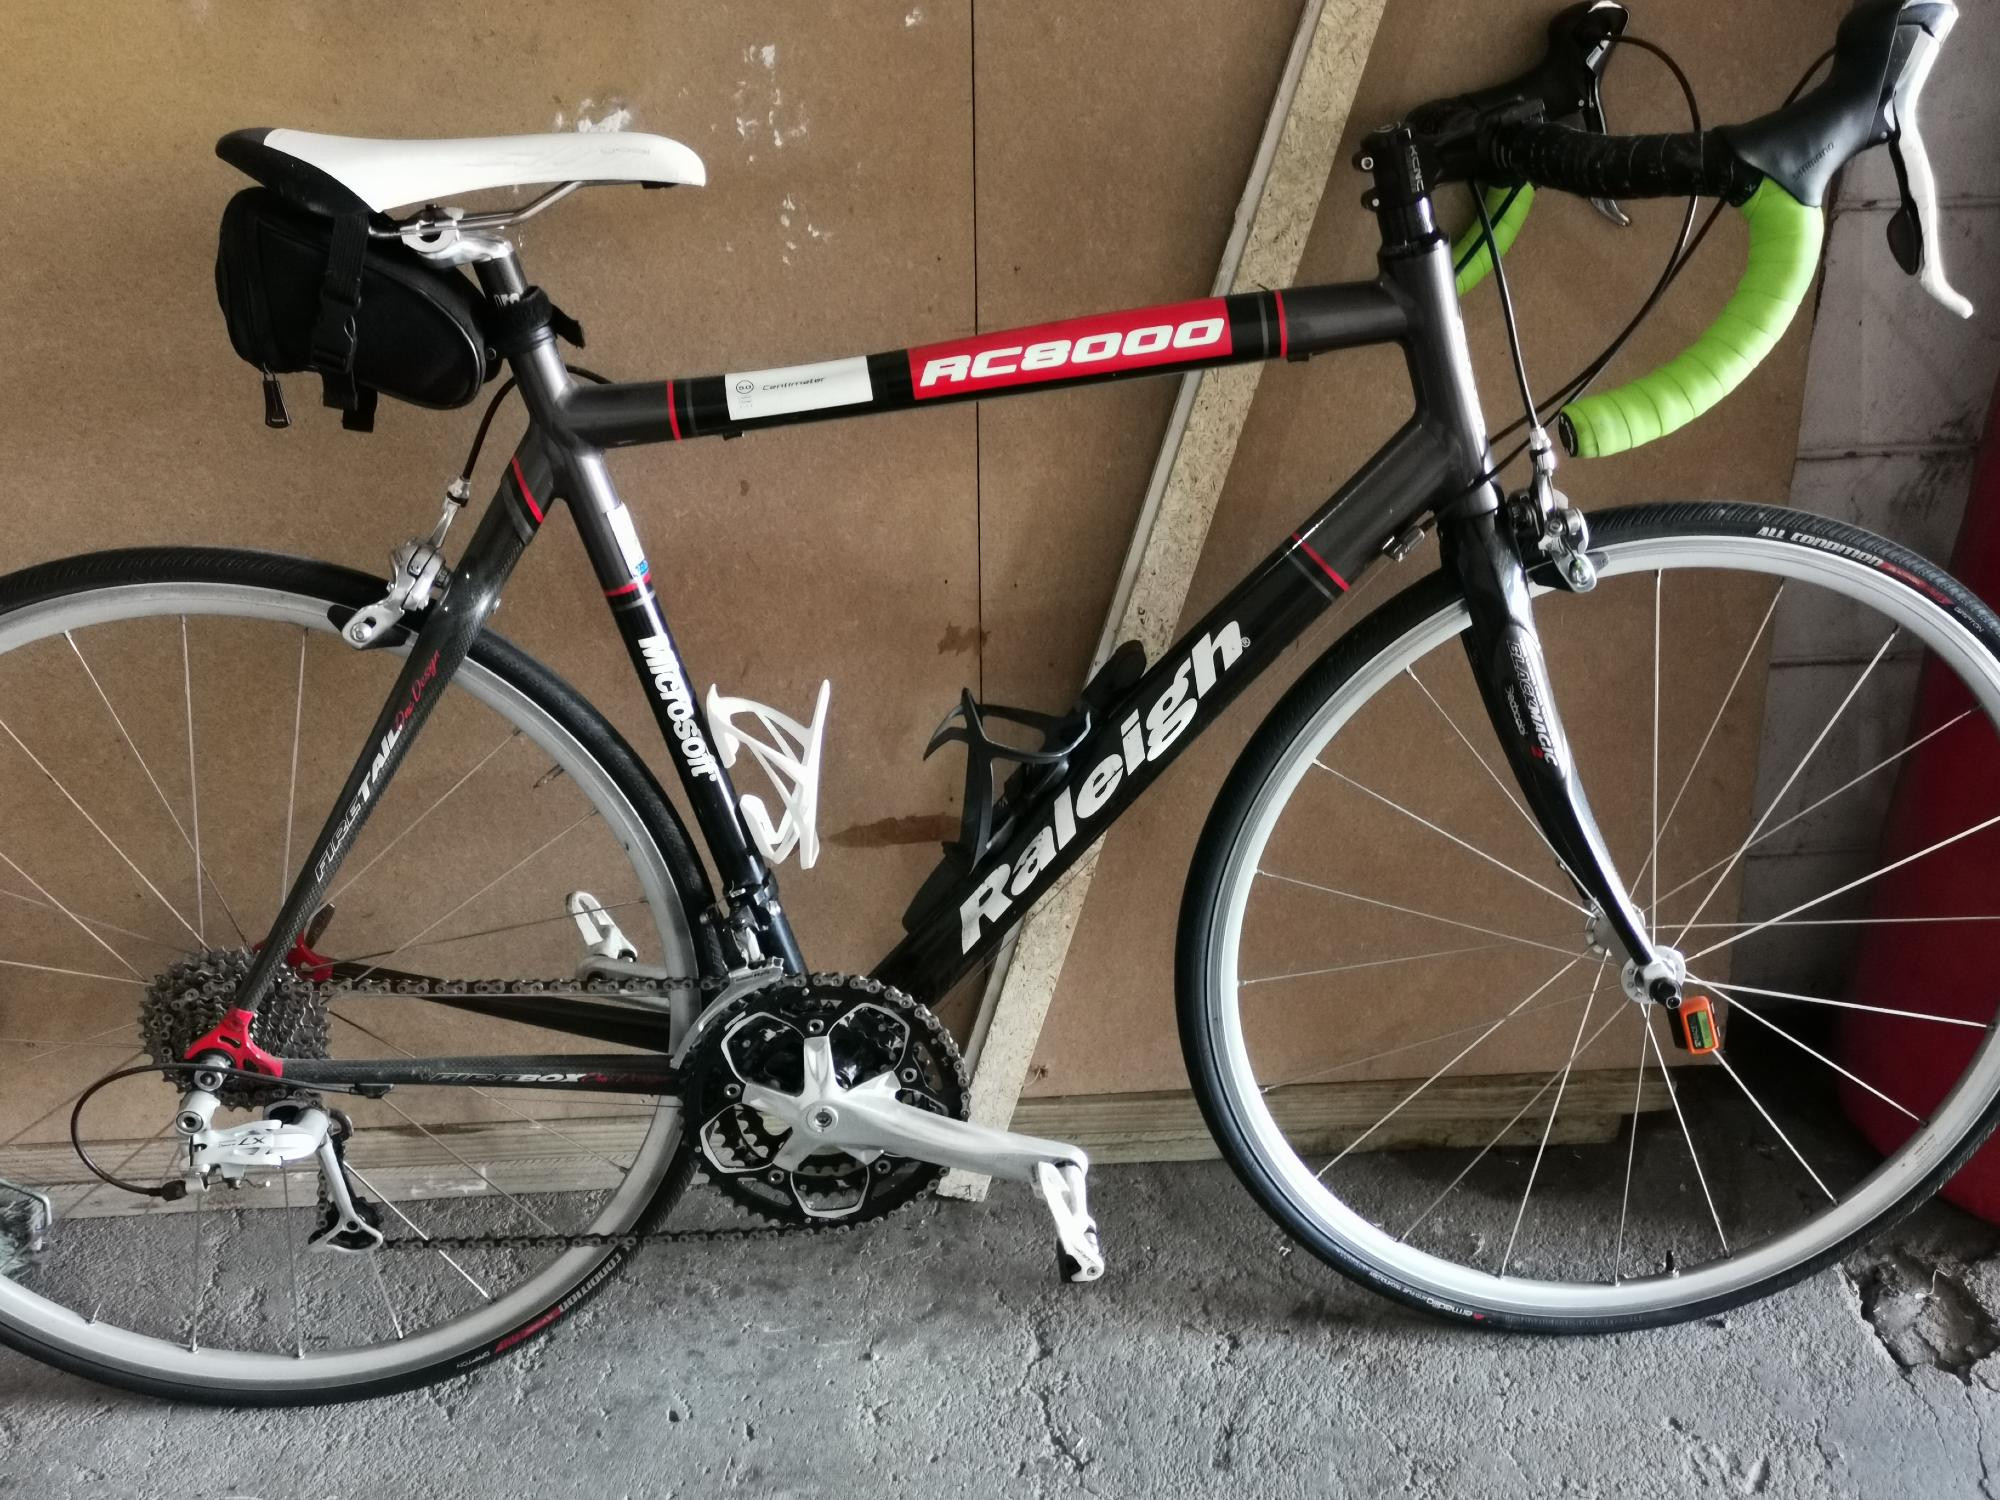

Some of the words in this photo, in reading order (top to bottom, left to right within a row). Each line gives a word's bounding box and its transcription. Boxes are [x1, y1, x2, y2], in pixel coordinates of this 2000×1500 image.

[920, 318, 1224, 386] RC8000
[762, 377, 825, 391] Centimeter
[1756, 526, 1786, 540] ALL
[638, 634, 717, 780] Microsoft
[960, 620, 1244, 955] Raleigh
[238, 1137, 264, 1146] LX
